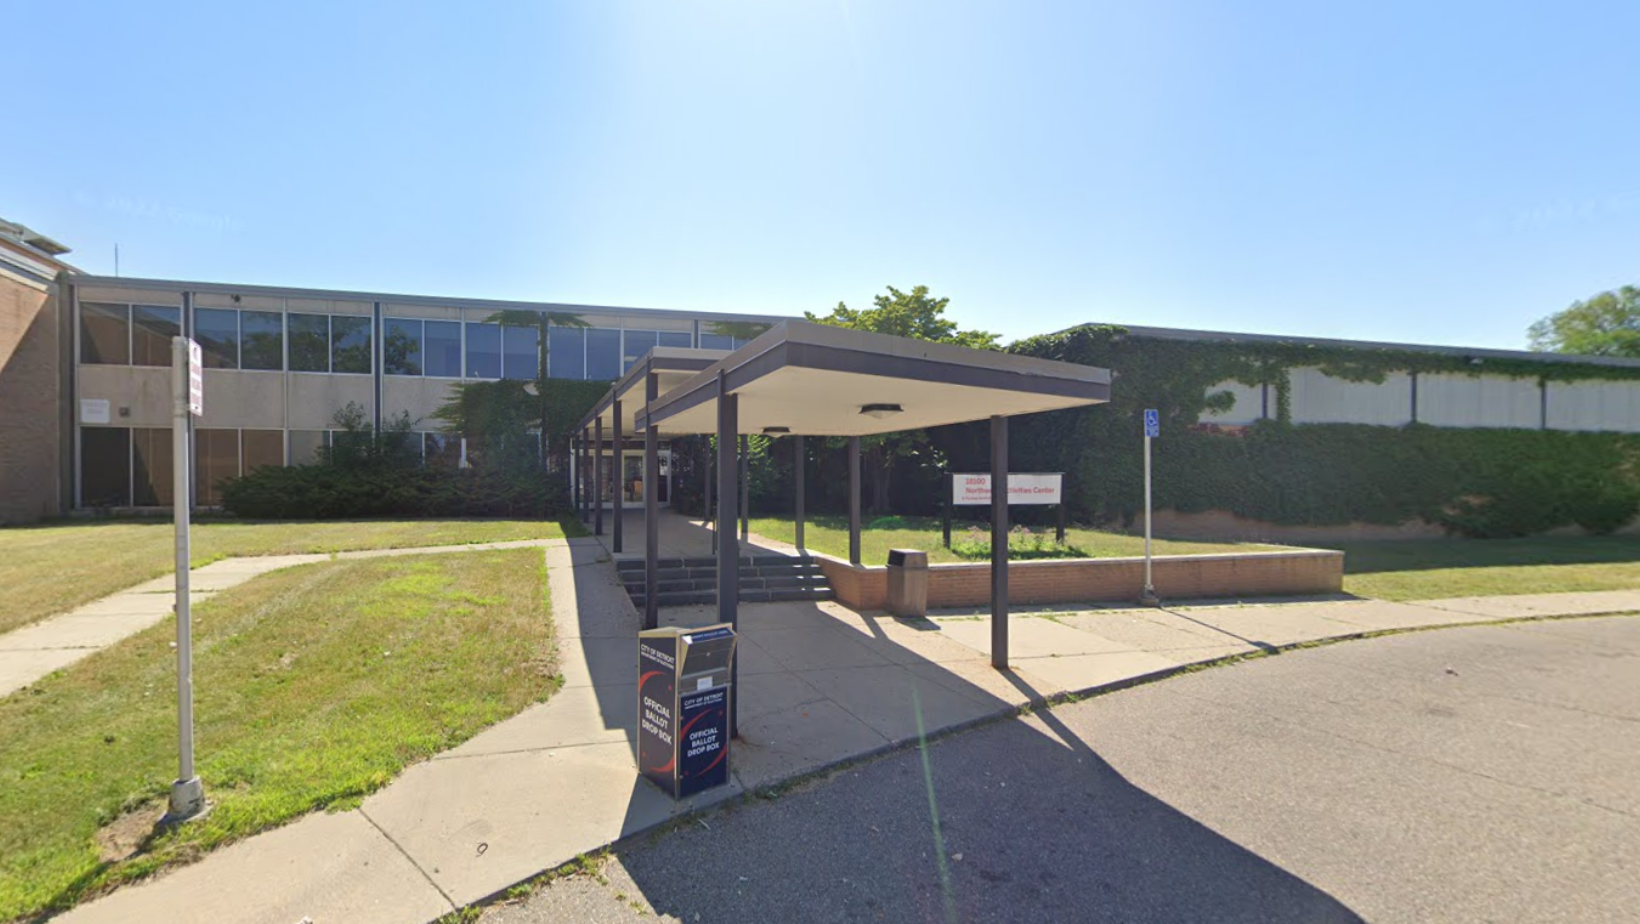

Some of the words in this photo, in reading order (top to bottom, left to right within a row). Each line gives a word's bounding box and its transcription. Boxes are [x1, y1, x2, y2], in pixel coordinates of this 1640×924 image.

[656, 650, 675, 664] DETROIT
[684, 698, 695, 706] CITY
[704, 692, 724, 702] DETROIT
[644, 696, 670, 719] OFFICIAL
[646, 709, 668, 730] BALLOT
[642, 718, 658, 735] DROP
[659, 729, 672, 745] BOX
[689, 727, 718, 740] OFFICIAL
[692, 735, 716, 748] BALLOT
[687, 746, 705, 757] DROP
[706, 742, 720, 752] BOX
